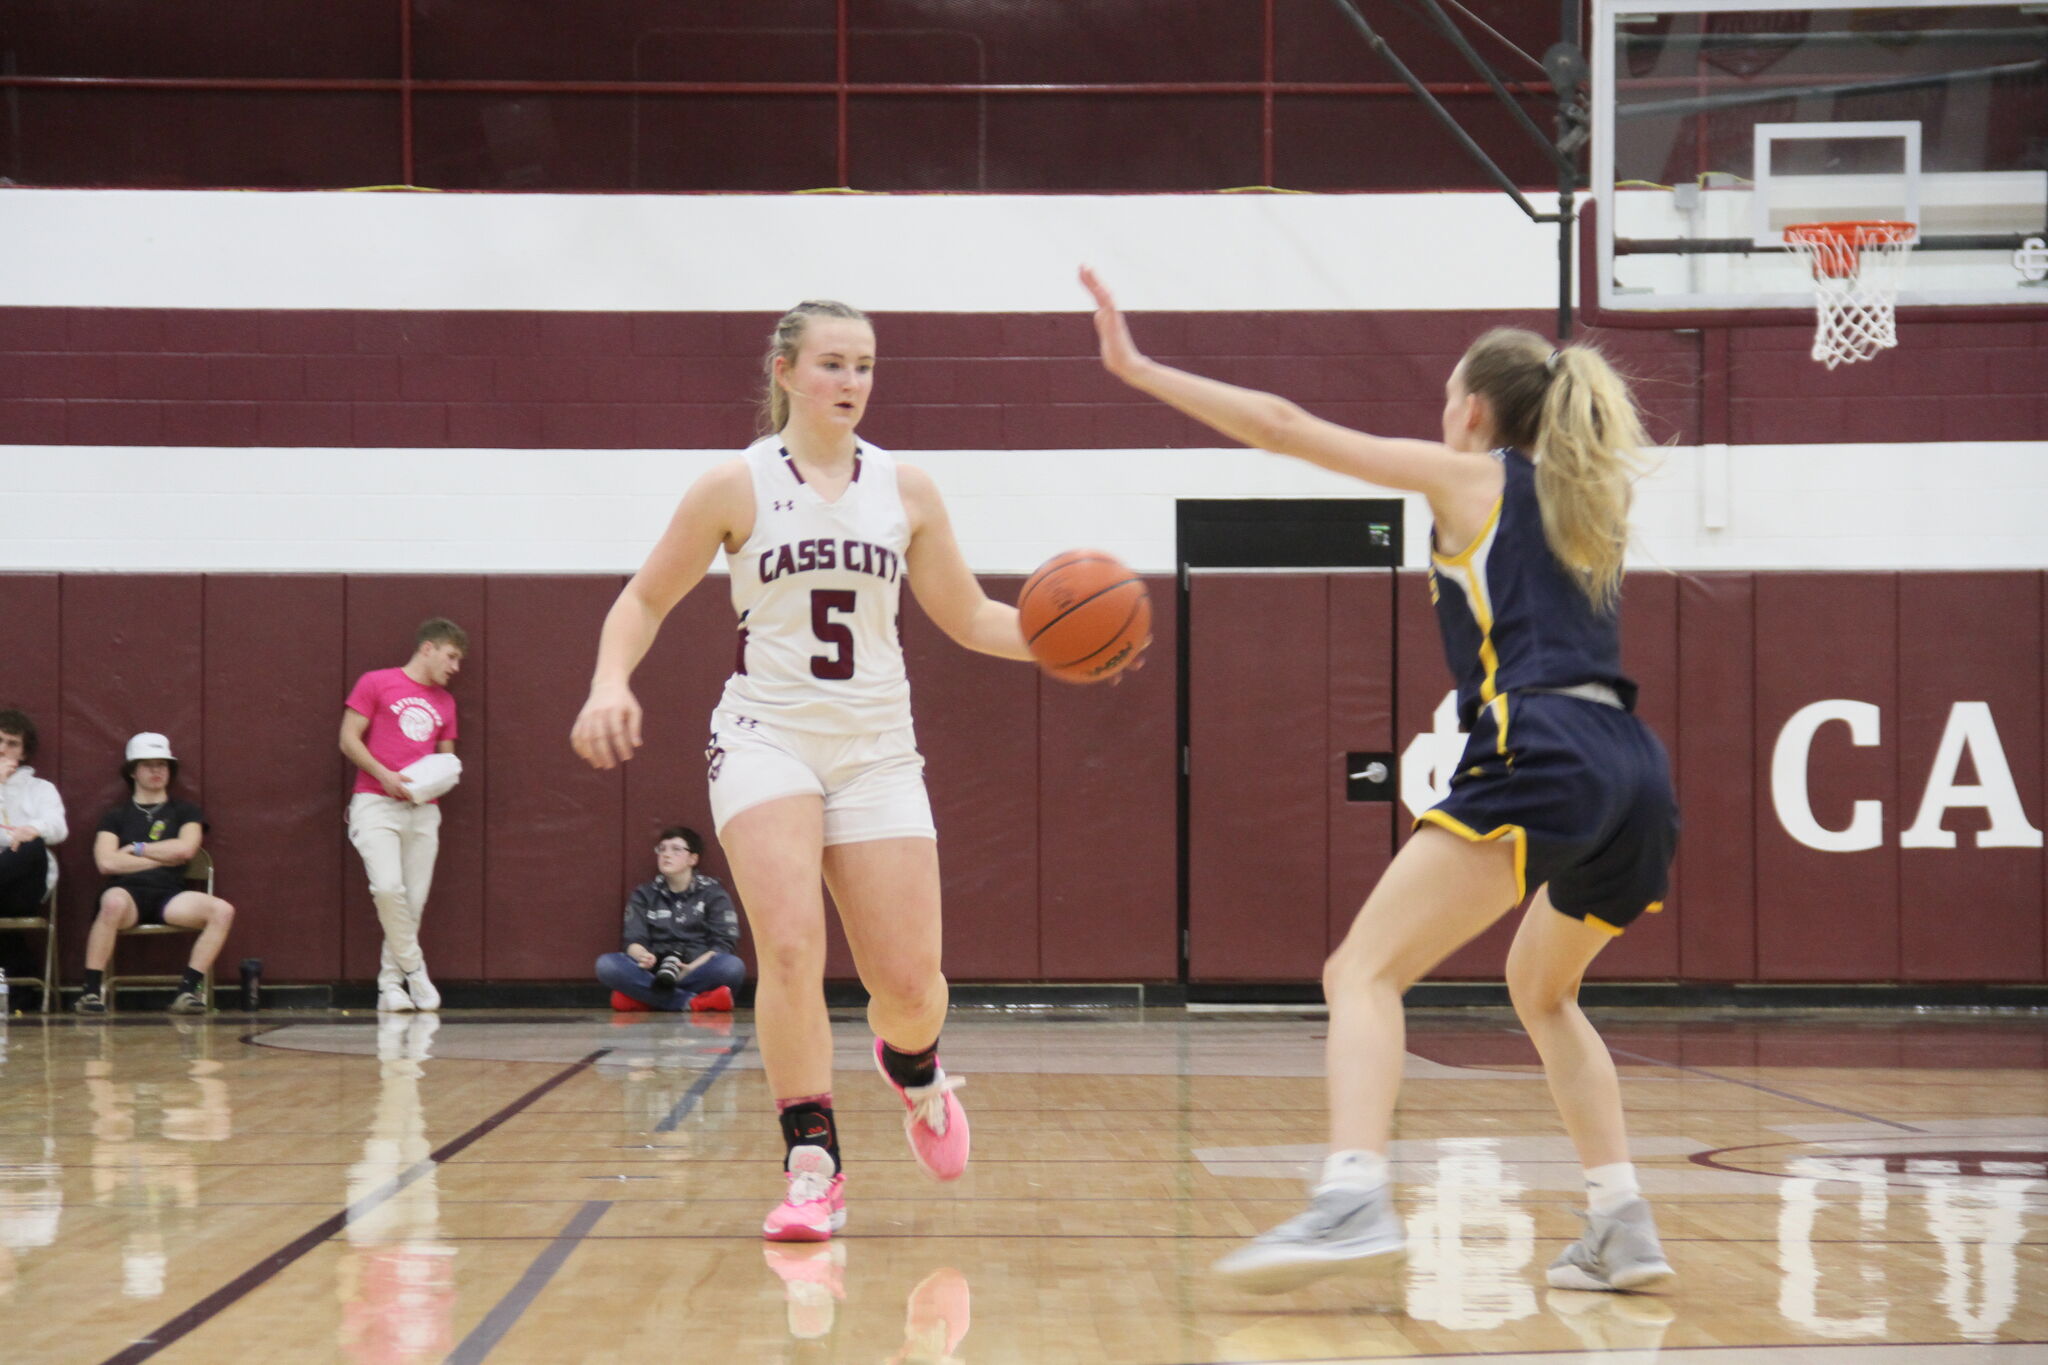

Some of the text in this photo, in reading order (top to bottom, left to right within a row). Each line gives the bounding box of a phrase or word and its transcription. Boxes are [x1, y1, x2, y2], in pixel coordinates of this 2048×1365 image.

[759, 538, 836, 584] CASS
[810, 588, 856, 680] 5
[1771, 699, 2043, 852] CA
